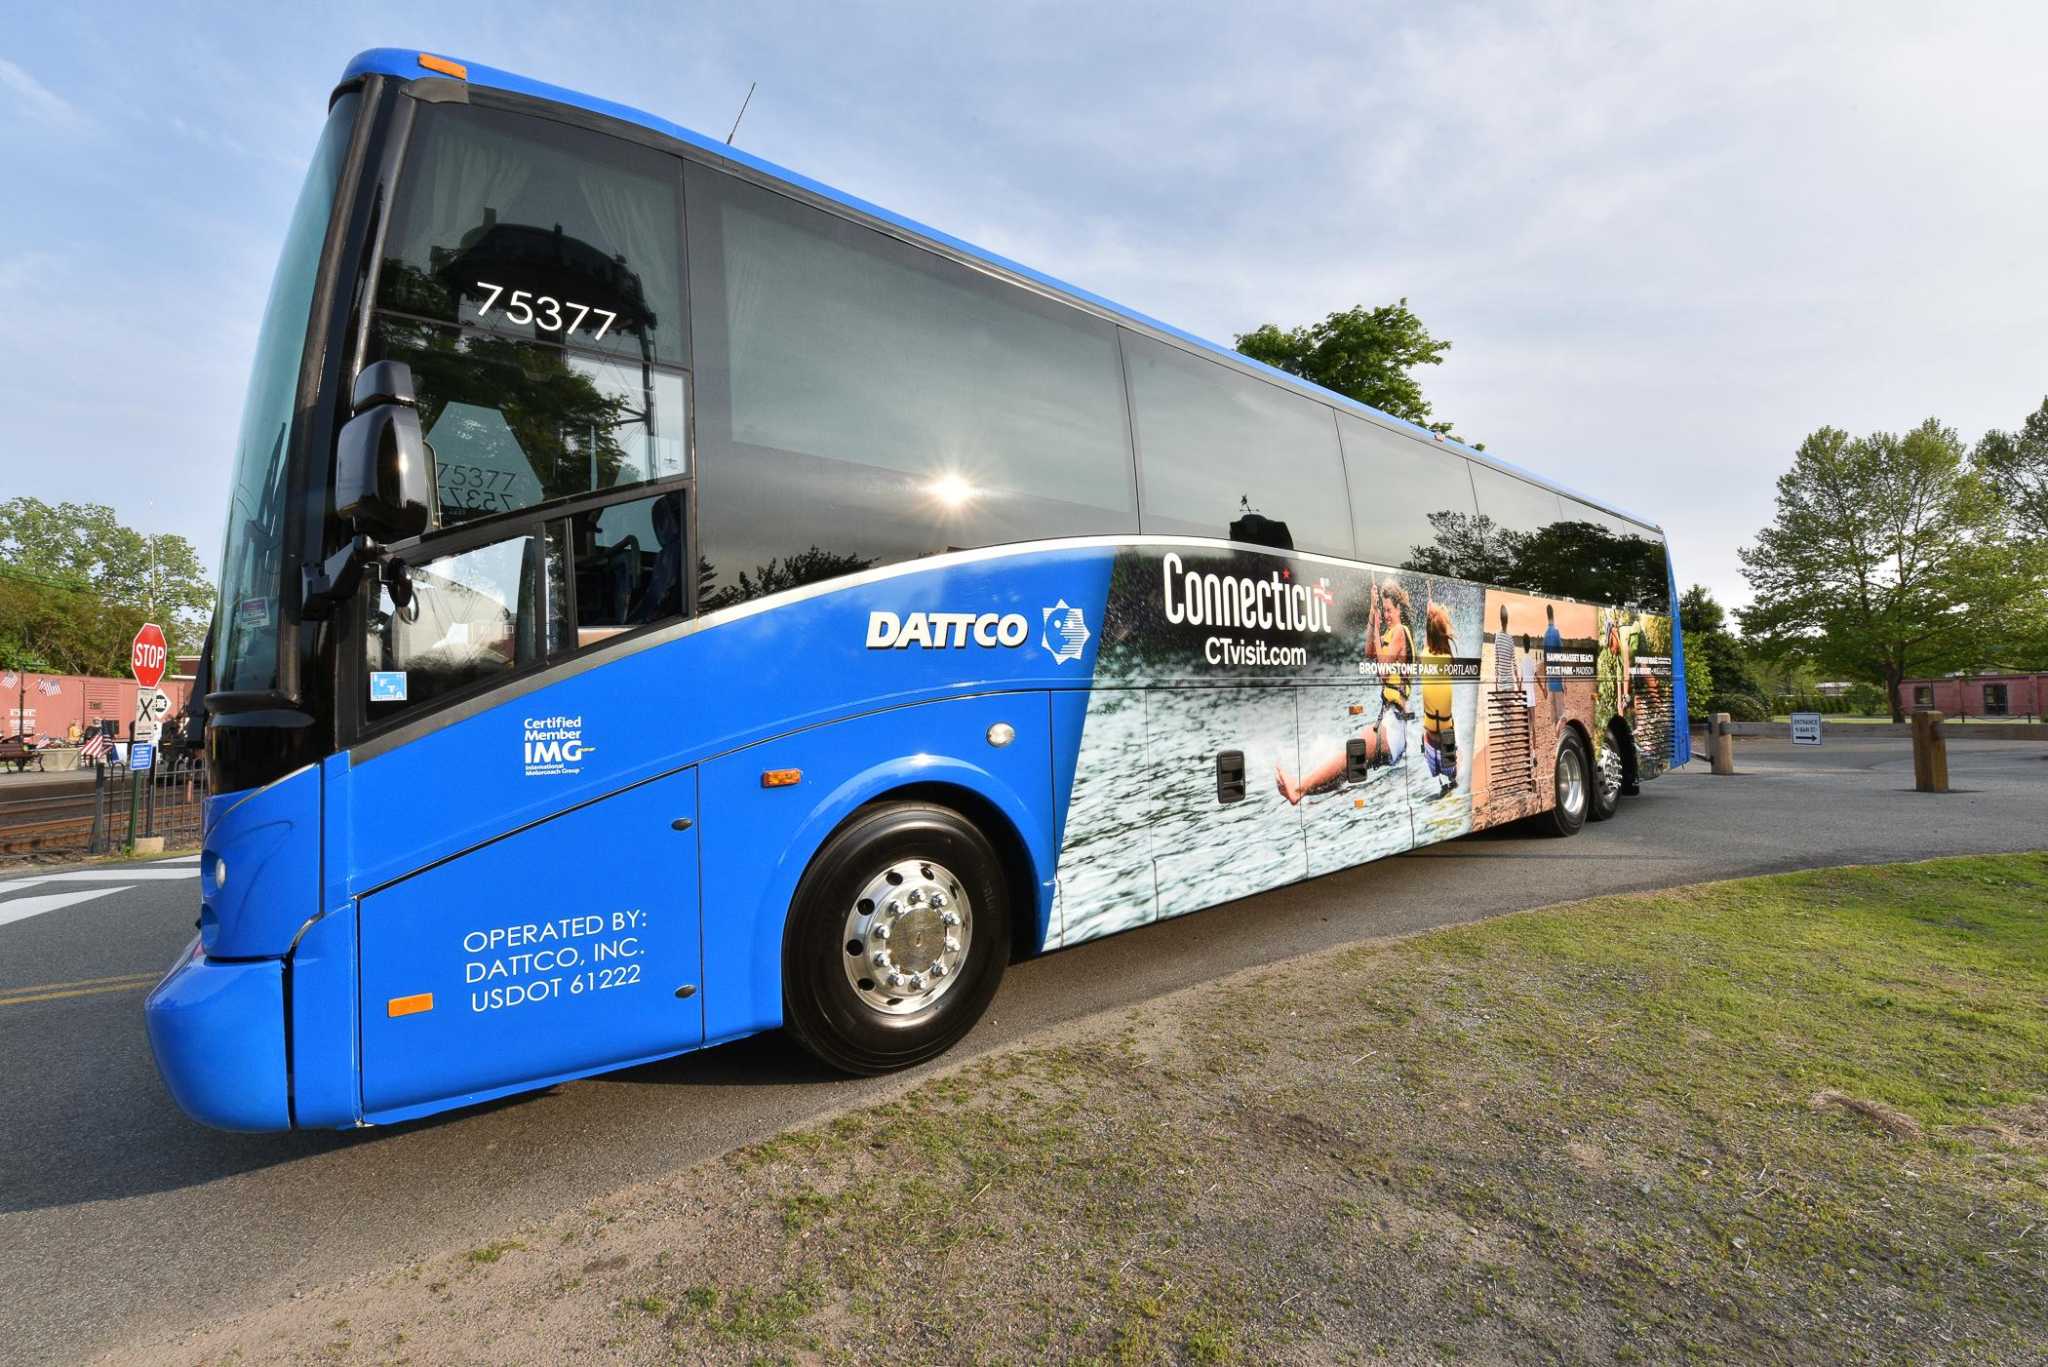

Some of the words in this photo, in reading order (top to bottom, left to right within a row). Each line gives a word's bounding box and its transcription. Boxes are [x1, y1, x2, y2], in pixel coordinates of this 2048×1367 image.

[476, 281, 617, 341] 75377
[1163, 552, 1332, 633] Connecticut
[865, 611, 1028, 650] DATTCO
[134, 642, 164, 669] STOP
[1205, 636, 1307, 666] CTvisit.com
[1359, 662, 1417, 675] BROWNSTONE
[1419, 663, 1439, 674] PARK
[1444, 664, 1478, 676] PORTLAND
[524, 716, 582, 729] Certified
[524, 728, 582, 741] Member
[524, 740, 583, 763] IMG
[463, 915, 604, 952] OPERATED
[612, 909, 647, 931] BY:
[466, 947, 585, 983] DATTCO,
[594, 937, 645, 962] INC.
[471, 978, 562, 1012] USDOT
[570, 964, 641, 994] 61222
